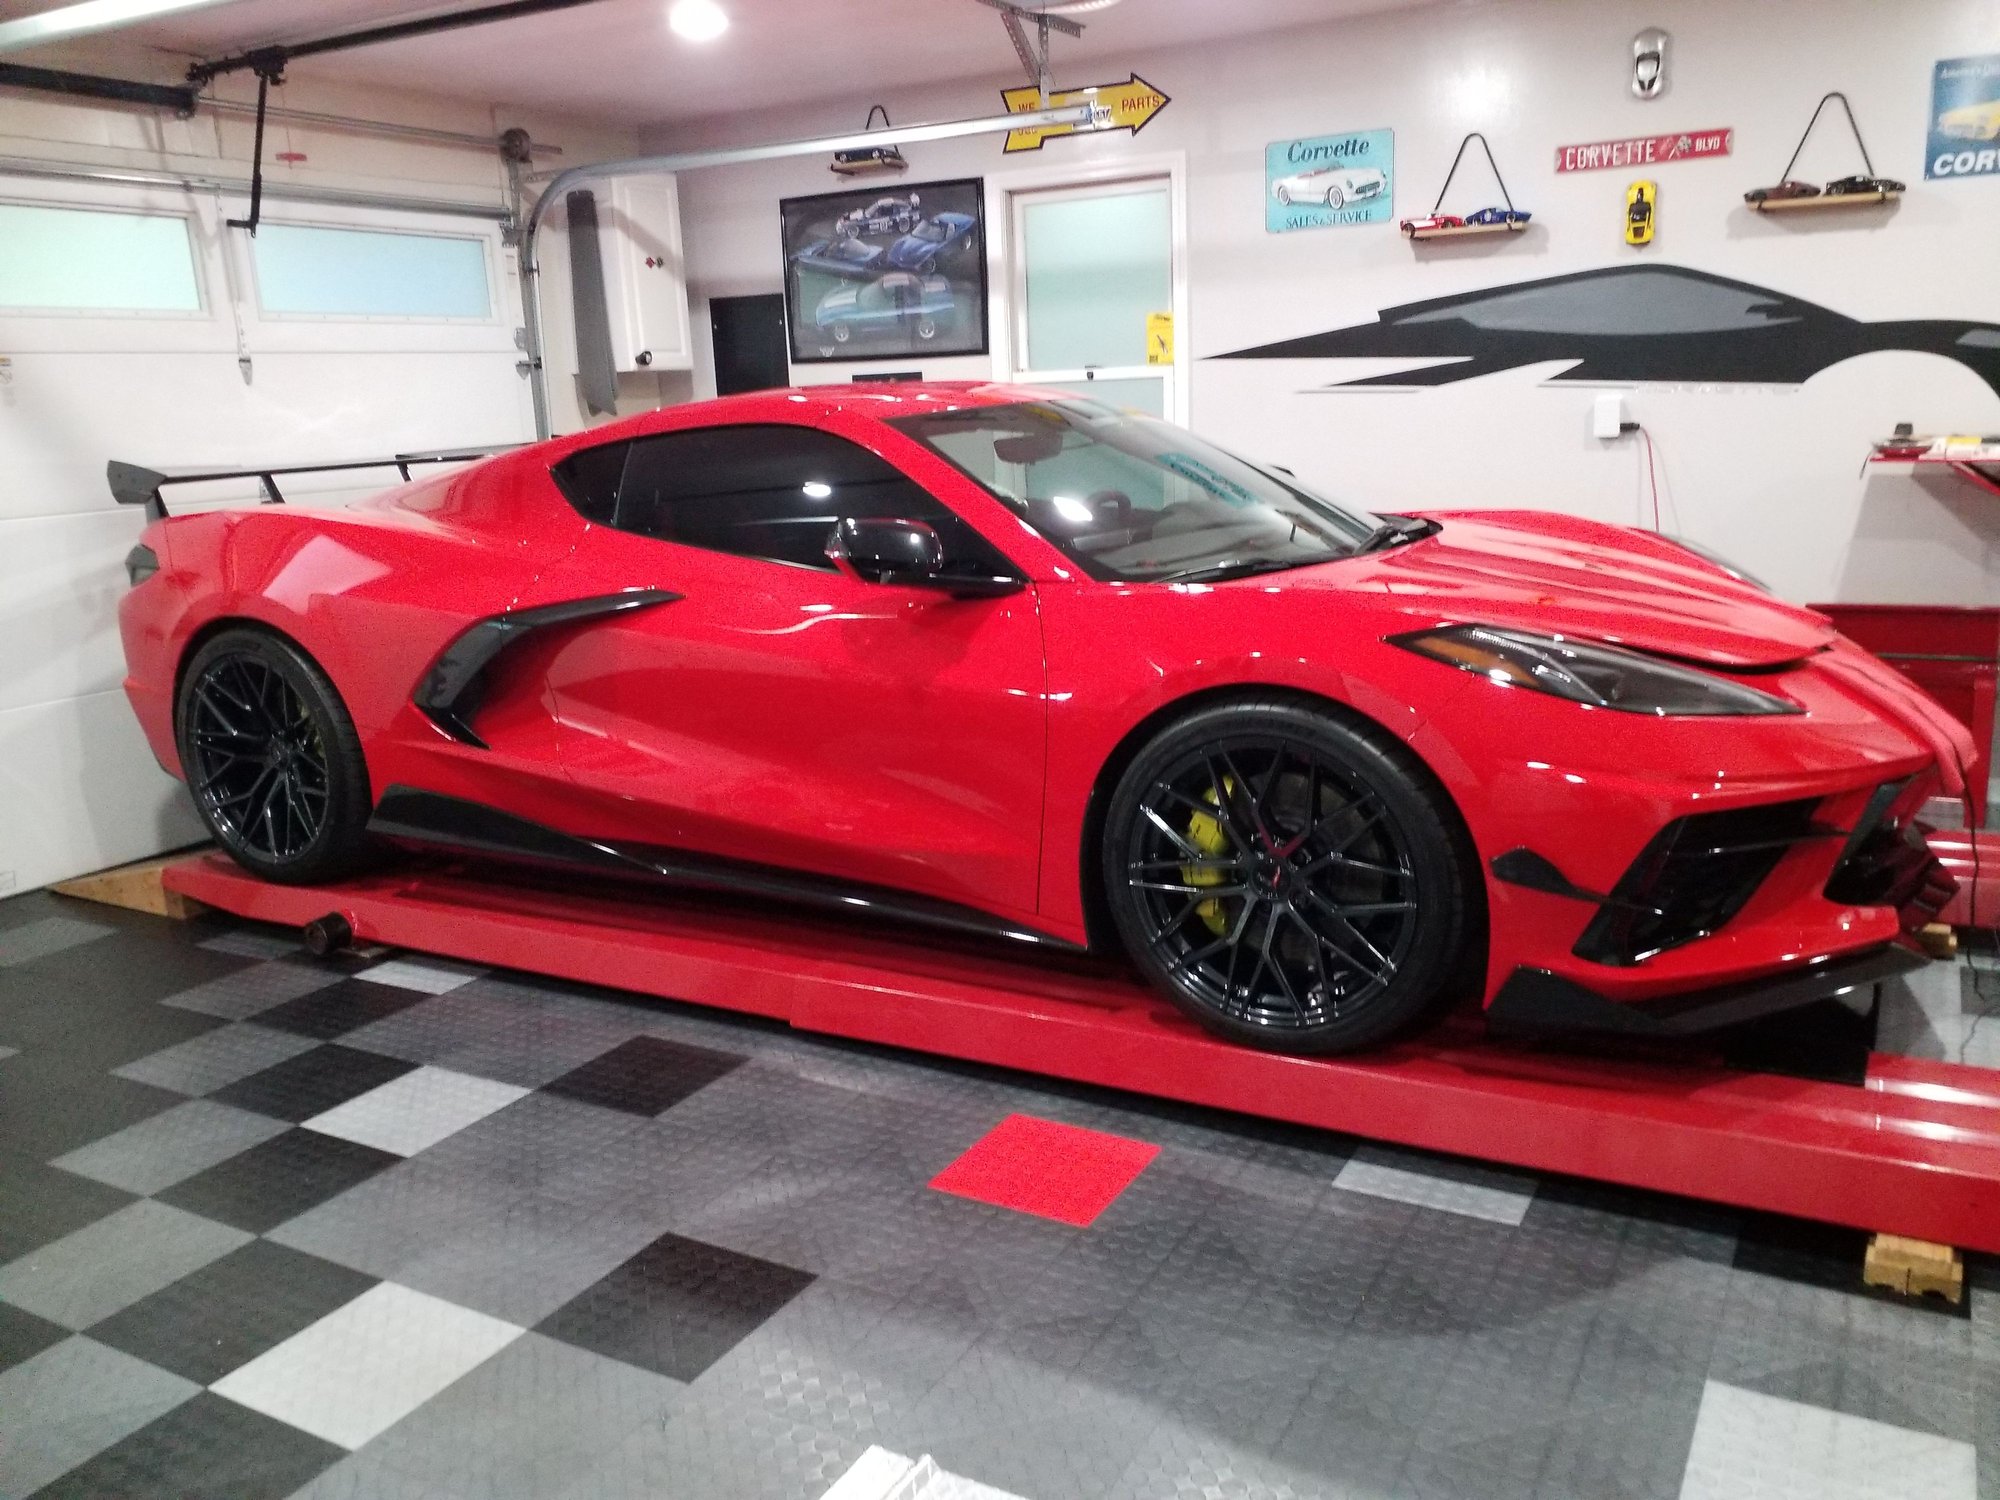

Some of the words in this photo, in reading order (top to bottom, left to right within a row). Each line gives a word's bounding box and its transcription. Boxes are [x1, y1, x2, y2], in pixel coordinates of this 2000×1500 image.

[1121, 95, 1160, 113] PARTS
[1287, 138, 1370, 163] Corvette
[1565, 139, 1657, 170] CORVETTE
[1695, 136, 1720, 152] BLVD
[1286, 214, 1318, 230] SALES
[1326, 209, 1372, 226] SERVICE
